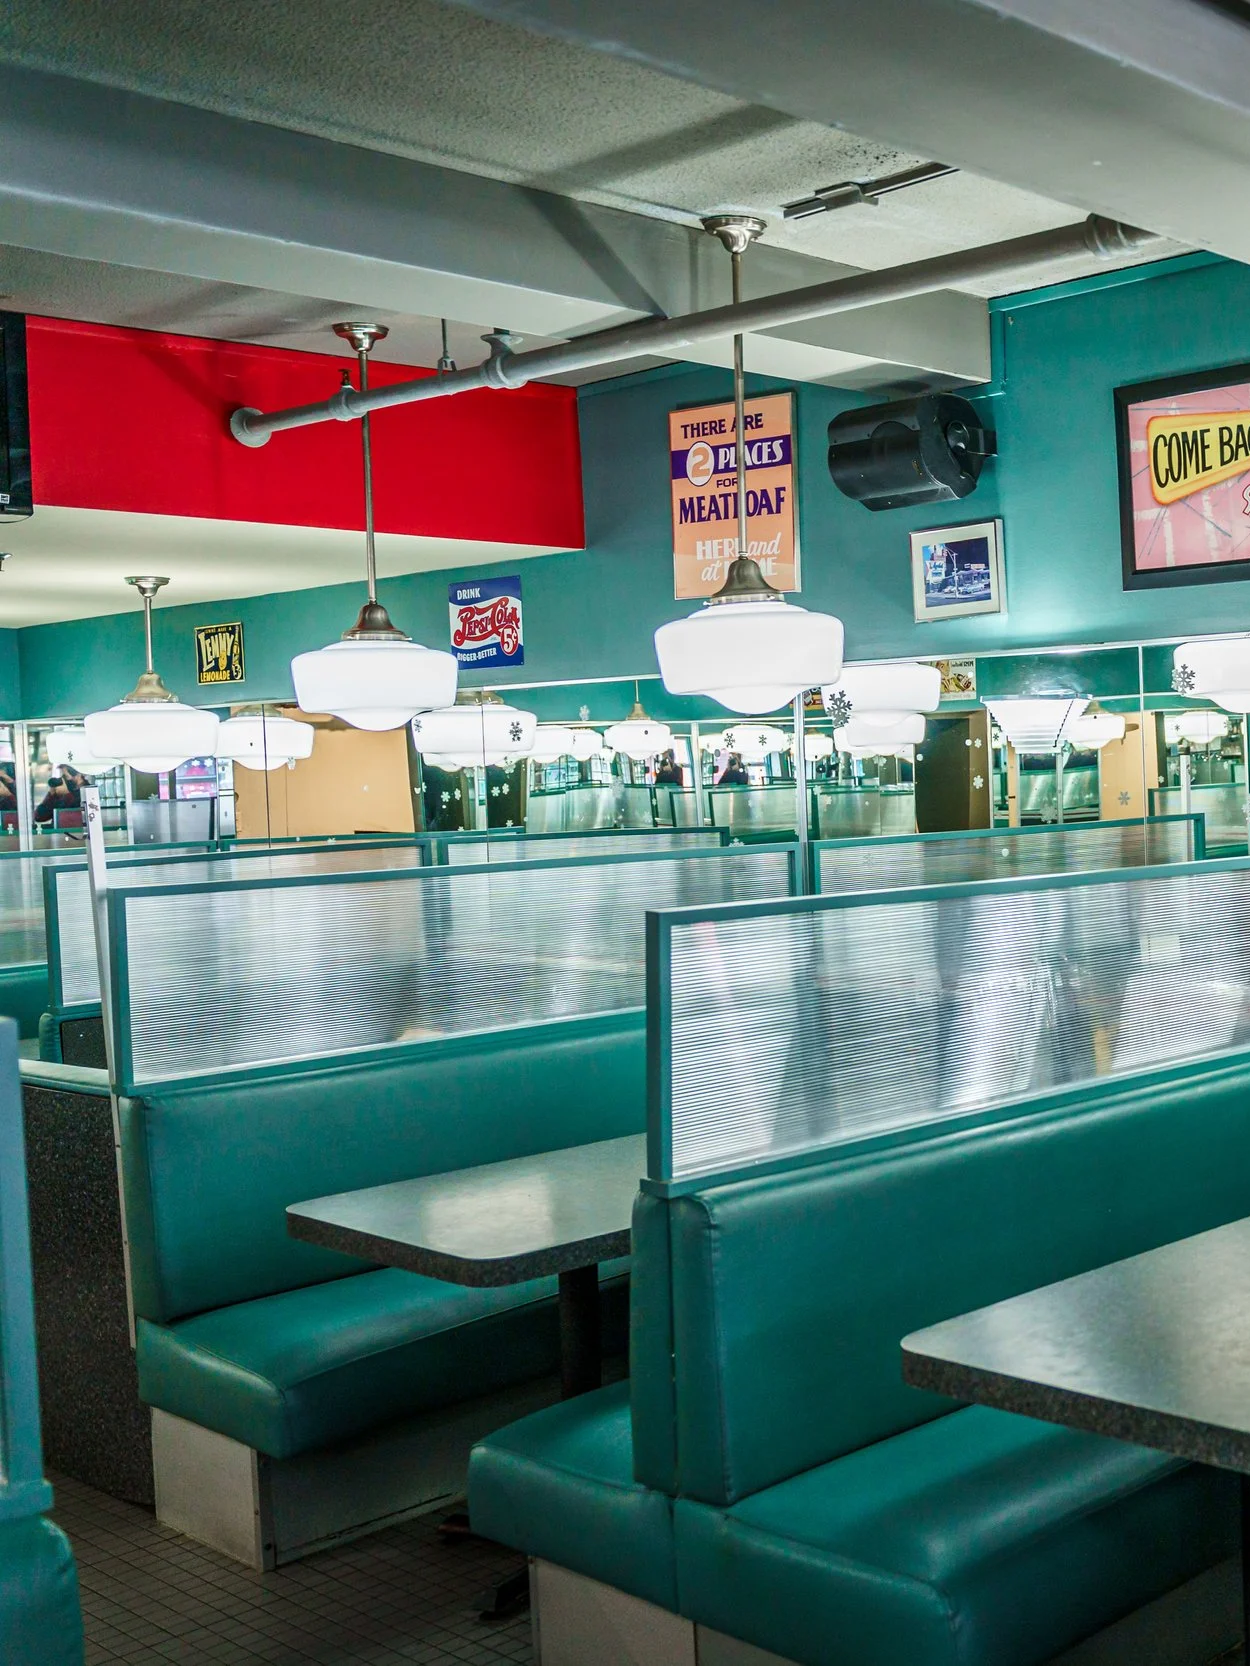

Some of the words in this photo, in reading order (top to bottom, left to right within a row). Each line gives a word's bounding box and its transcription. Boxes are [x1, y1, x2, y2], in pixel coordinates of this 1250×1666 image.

[681, 419, 727, 439] THERE
[691, 446, 710, 478] 2
[1153, 428, 1213, 488] COME
[747, 532, 782, 556] and
[701, 560, 722, 581] at
[457, 588, 481, 600] DRINK
[200, 670, 231, 682] LEMONADE
